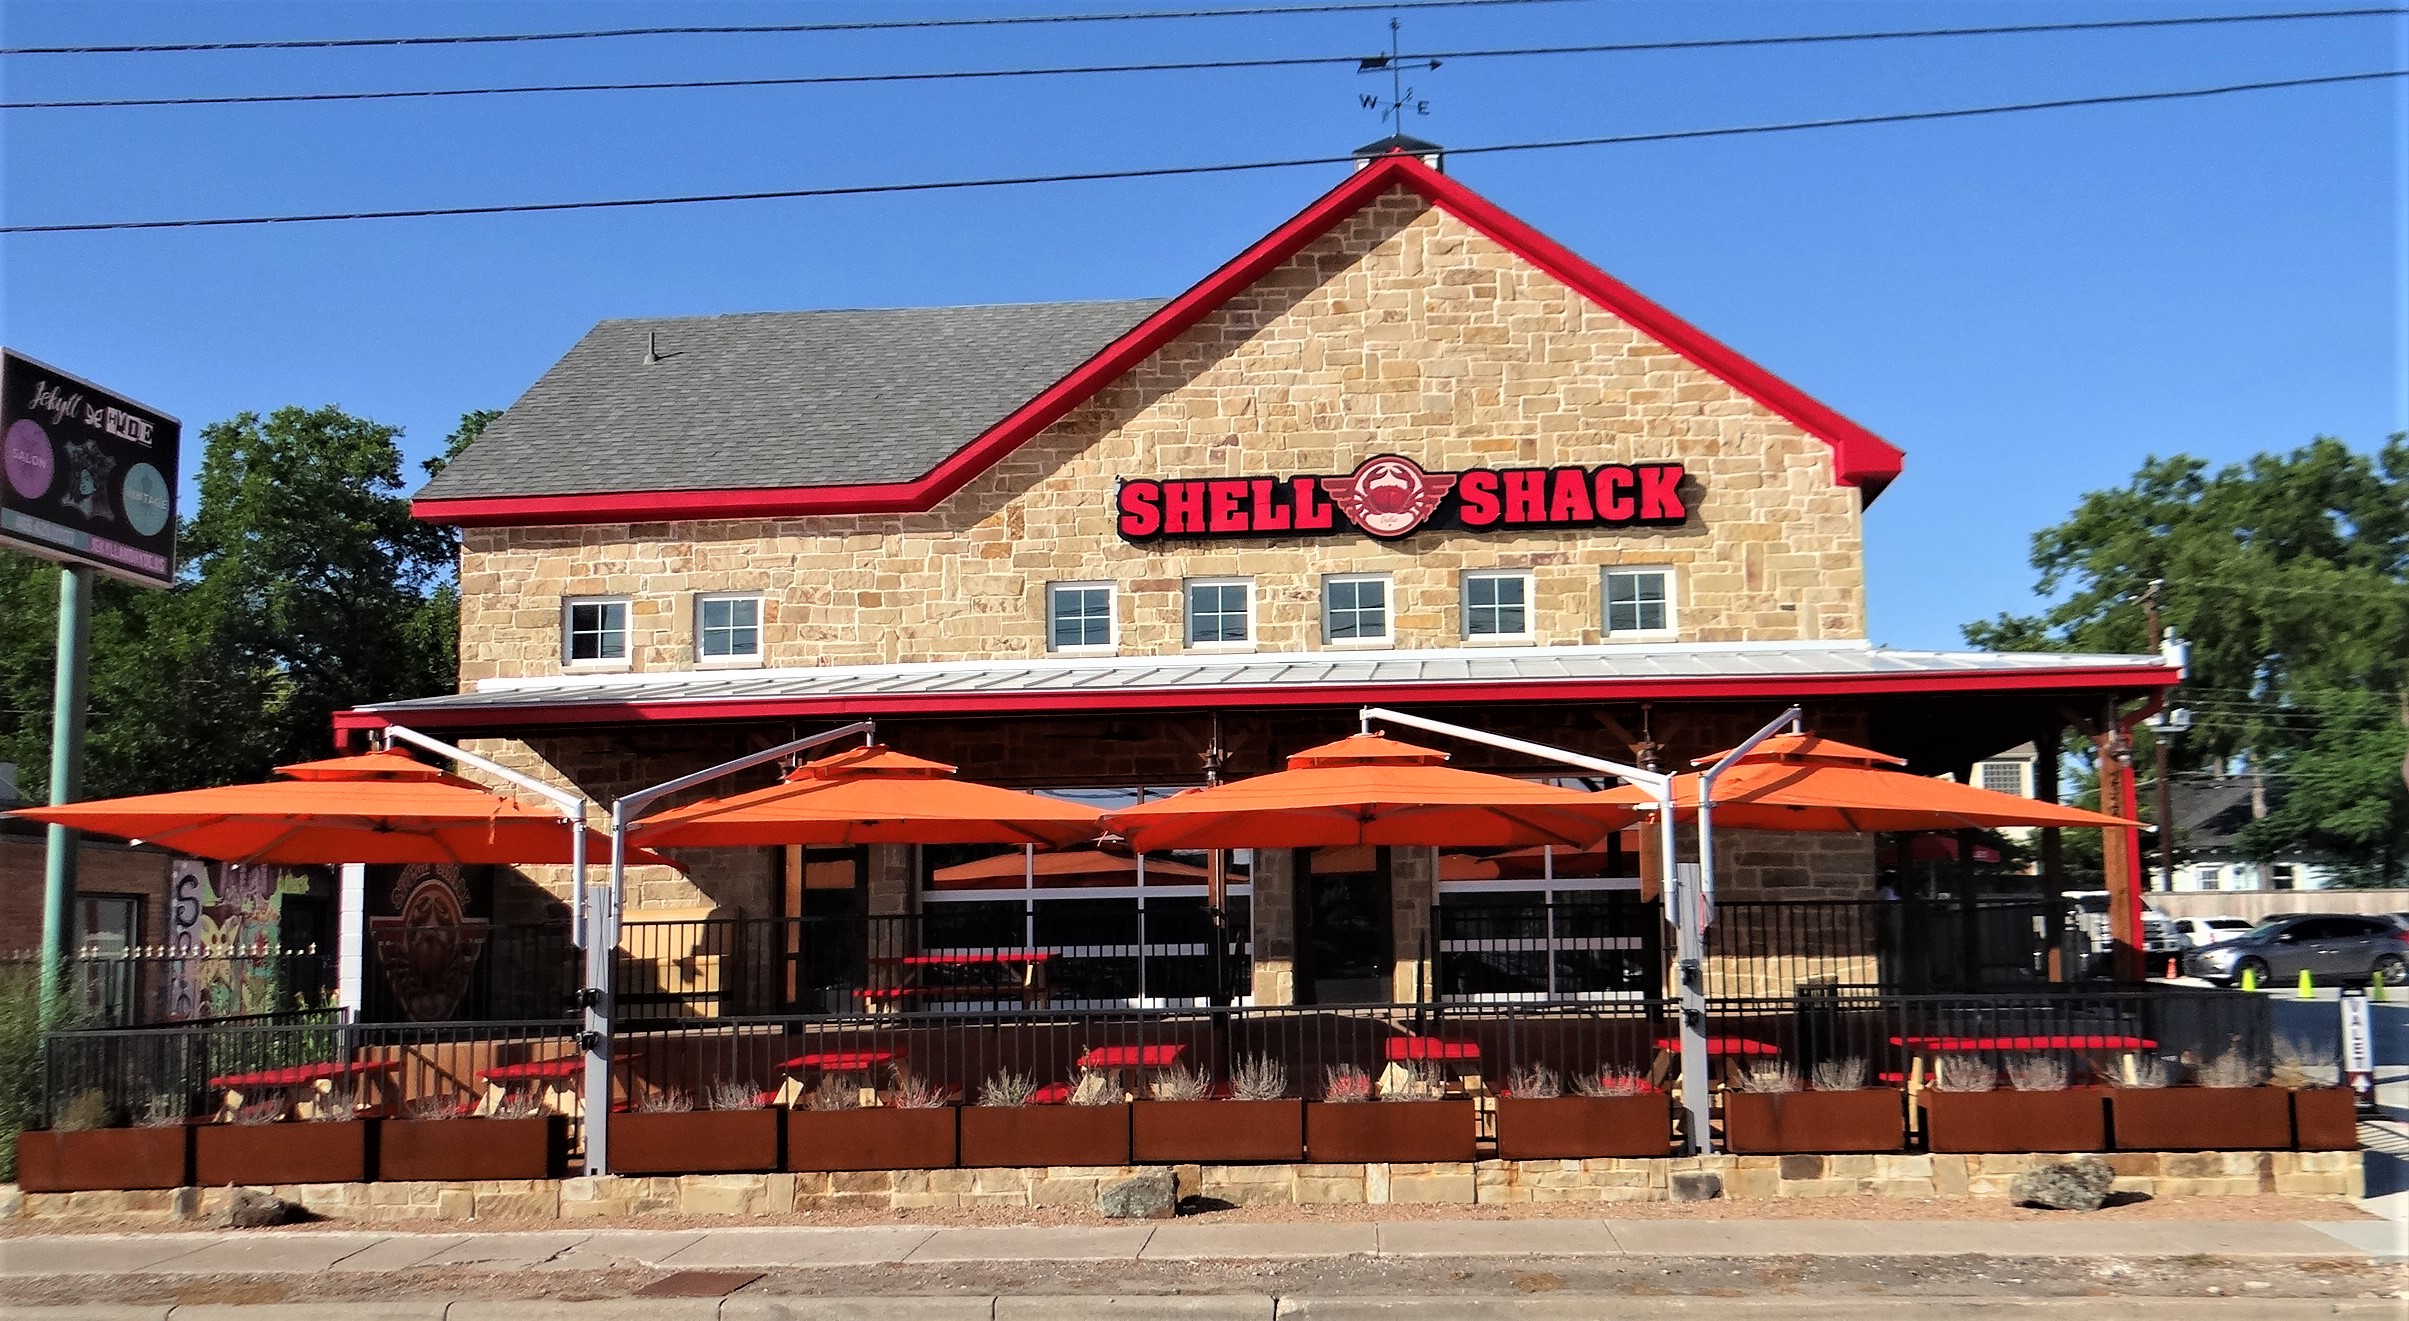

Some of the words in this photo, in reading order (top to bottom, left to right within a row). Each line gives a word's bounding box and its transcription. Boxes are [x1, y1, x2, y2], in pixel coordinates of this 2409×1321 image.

[1359, 93, 1378, 111] W
[1417, 101, 1430, 115] E
[28, 380, 83, 425] Jekyll
[105, 406, 153, 447] HYDE
[1120, 478, 1333, 536] SHELL
[1459, 466, 1686, 525] SHACK
[2349, 1000, 2366, 1069] VALET
